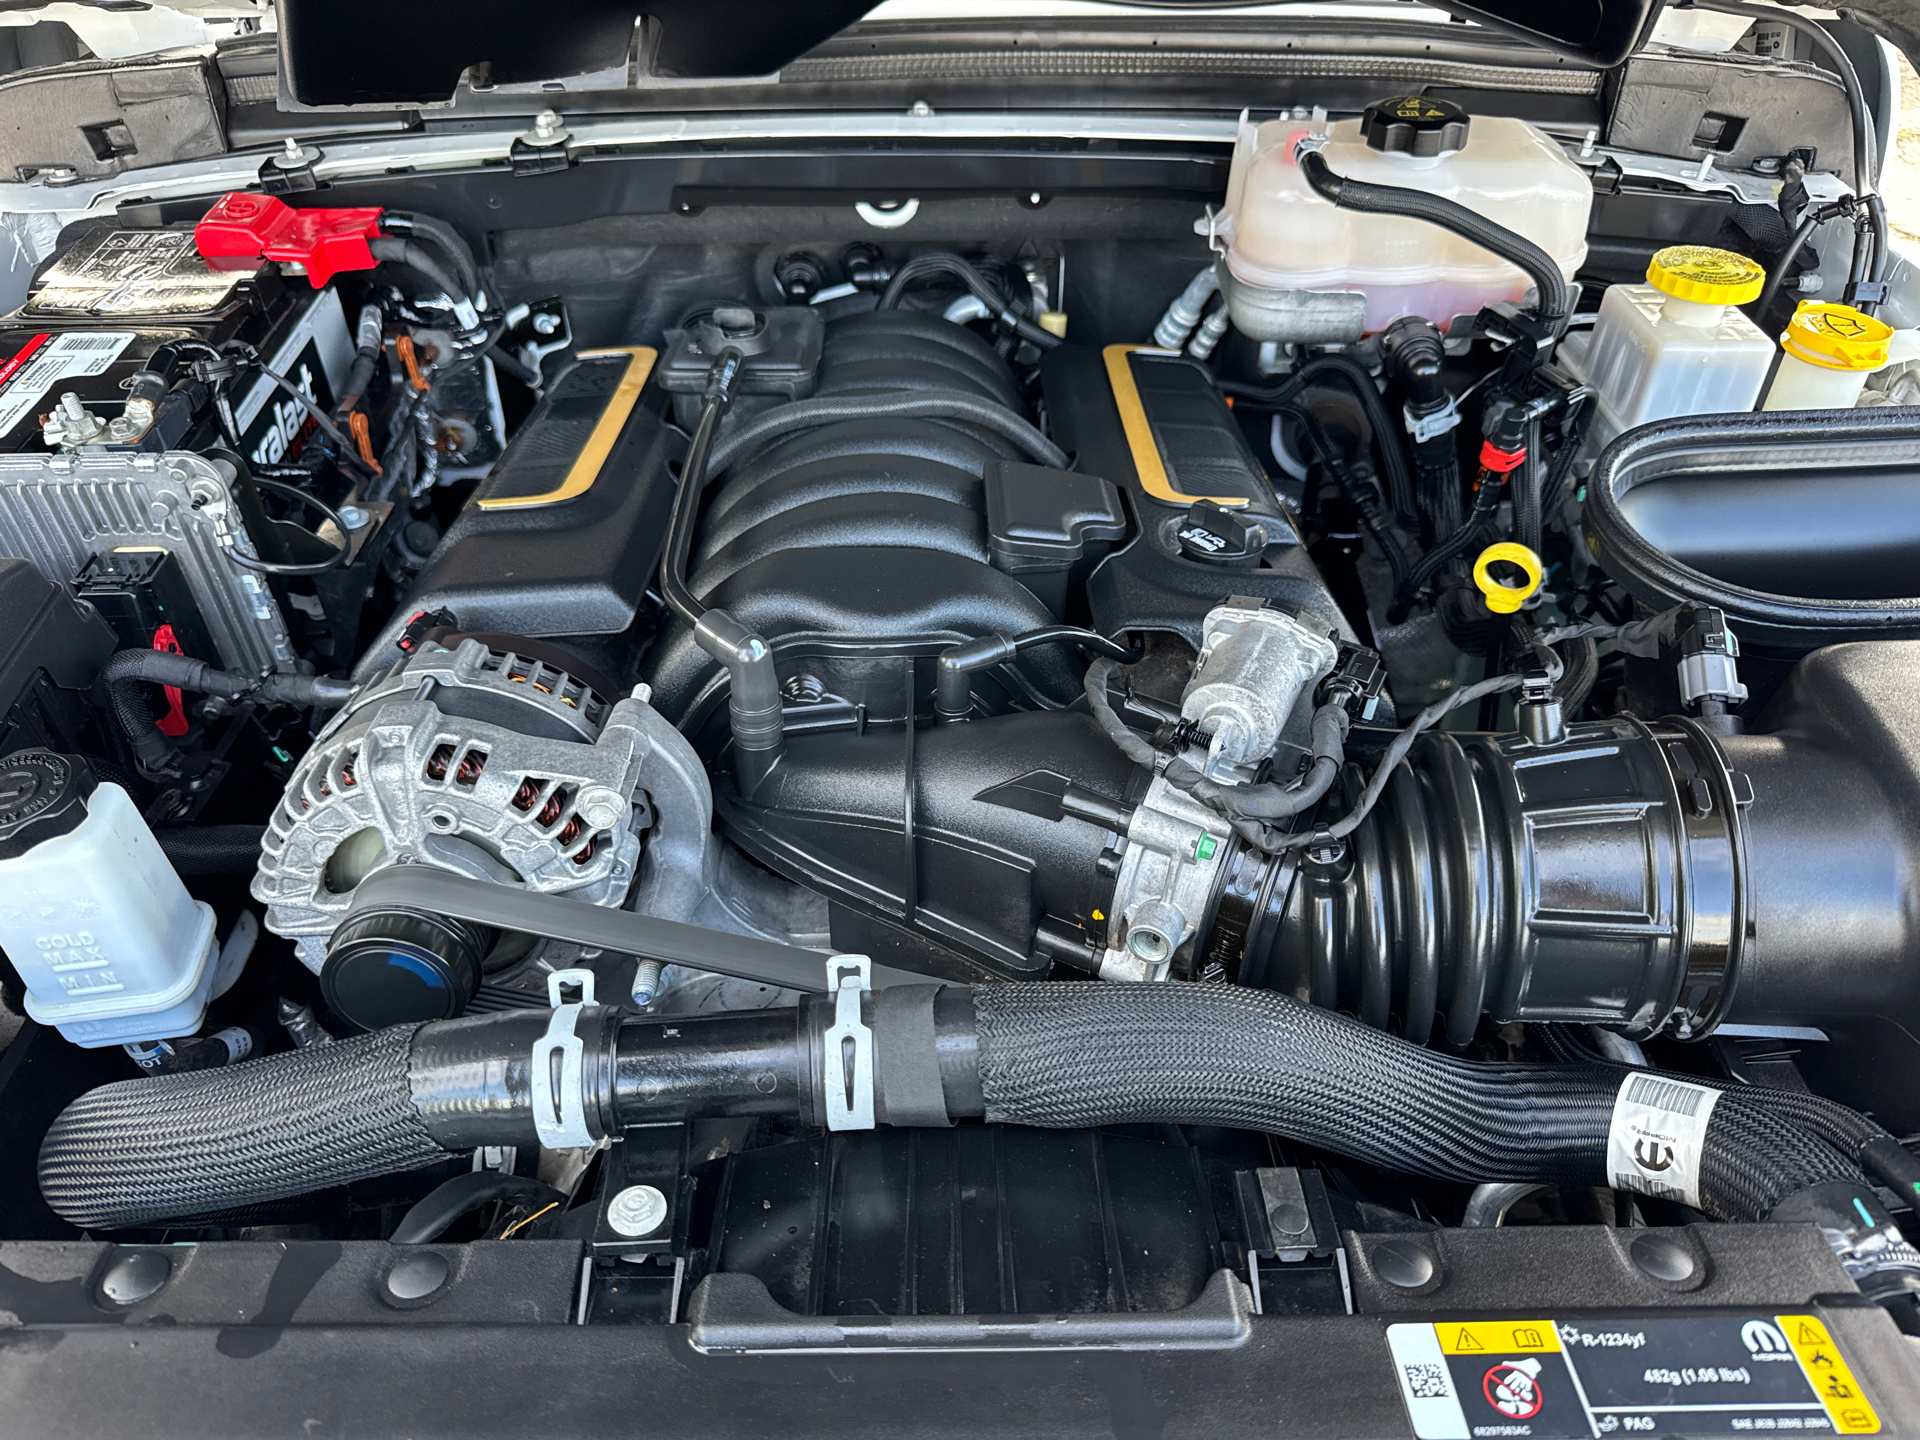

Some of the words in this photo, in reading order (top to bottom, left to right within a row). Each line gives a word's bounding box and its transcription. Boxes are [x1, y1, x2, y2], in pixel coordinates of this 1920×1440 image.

[252, 363, 318, 464] ralast
[35, 932, 96, 950] COLD
[43, 947, 107, 966] MAX
[59, 971, 120, 990] MIN
[1643, 1368, 1682, 1386] 482g
[1718, 1366, 1751, 1385] lbs)
[1622, 1416, 1656, 1431] PAG
